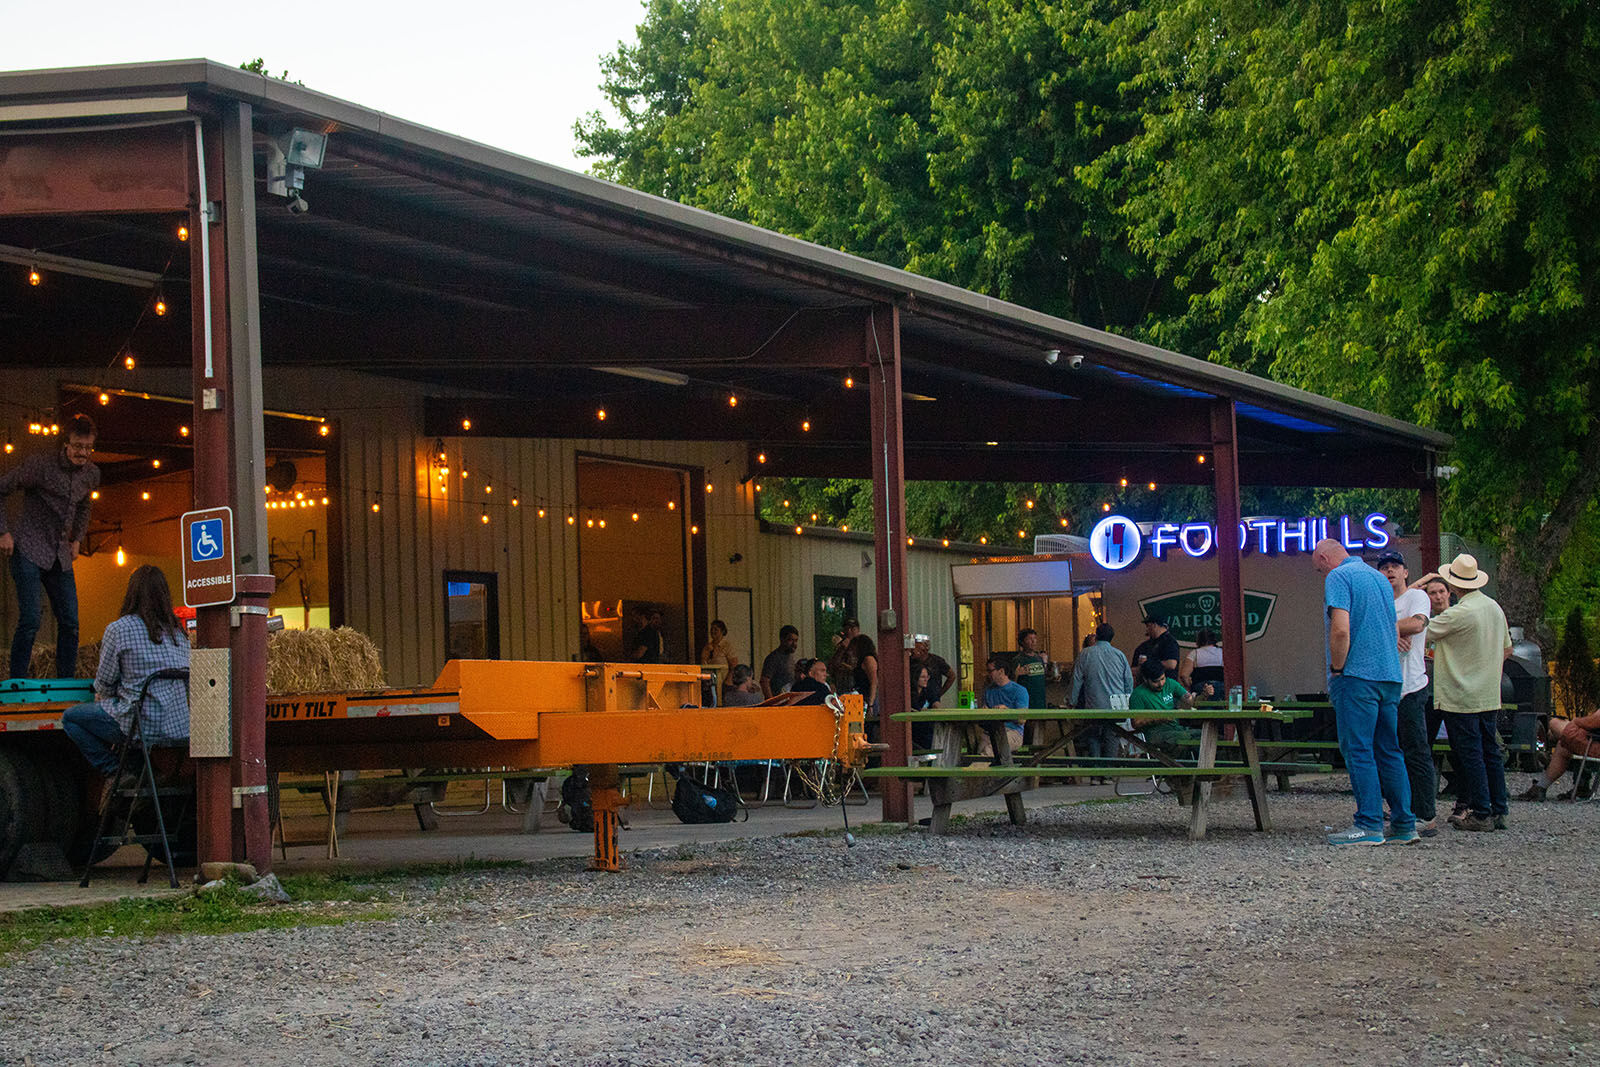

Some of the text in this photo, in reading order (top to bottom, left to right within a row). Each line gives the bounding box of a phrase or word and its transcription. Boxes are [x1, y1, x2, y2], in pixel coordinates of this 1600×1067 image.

[187, 575, 232, 589] ACCESSIBLE
[1167, 612, 1259, 628] ATERSD
[305, 701, 337, 717] TILT
[1348, 831, 1365, 839] HOKA
